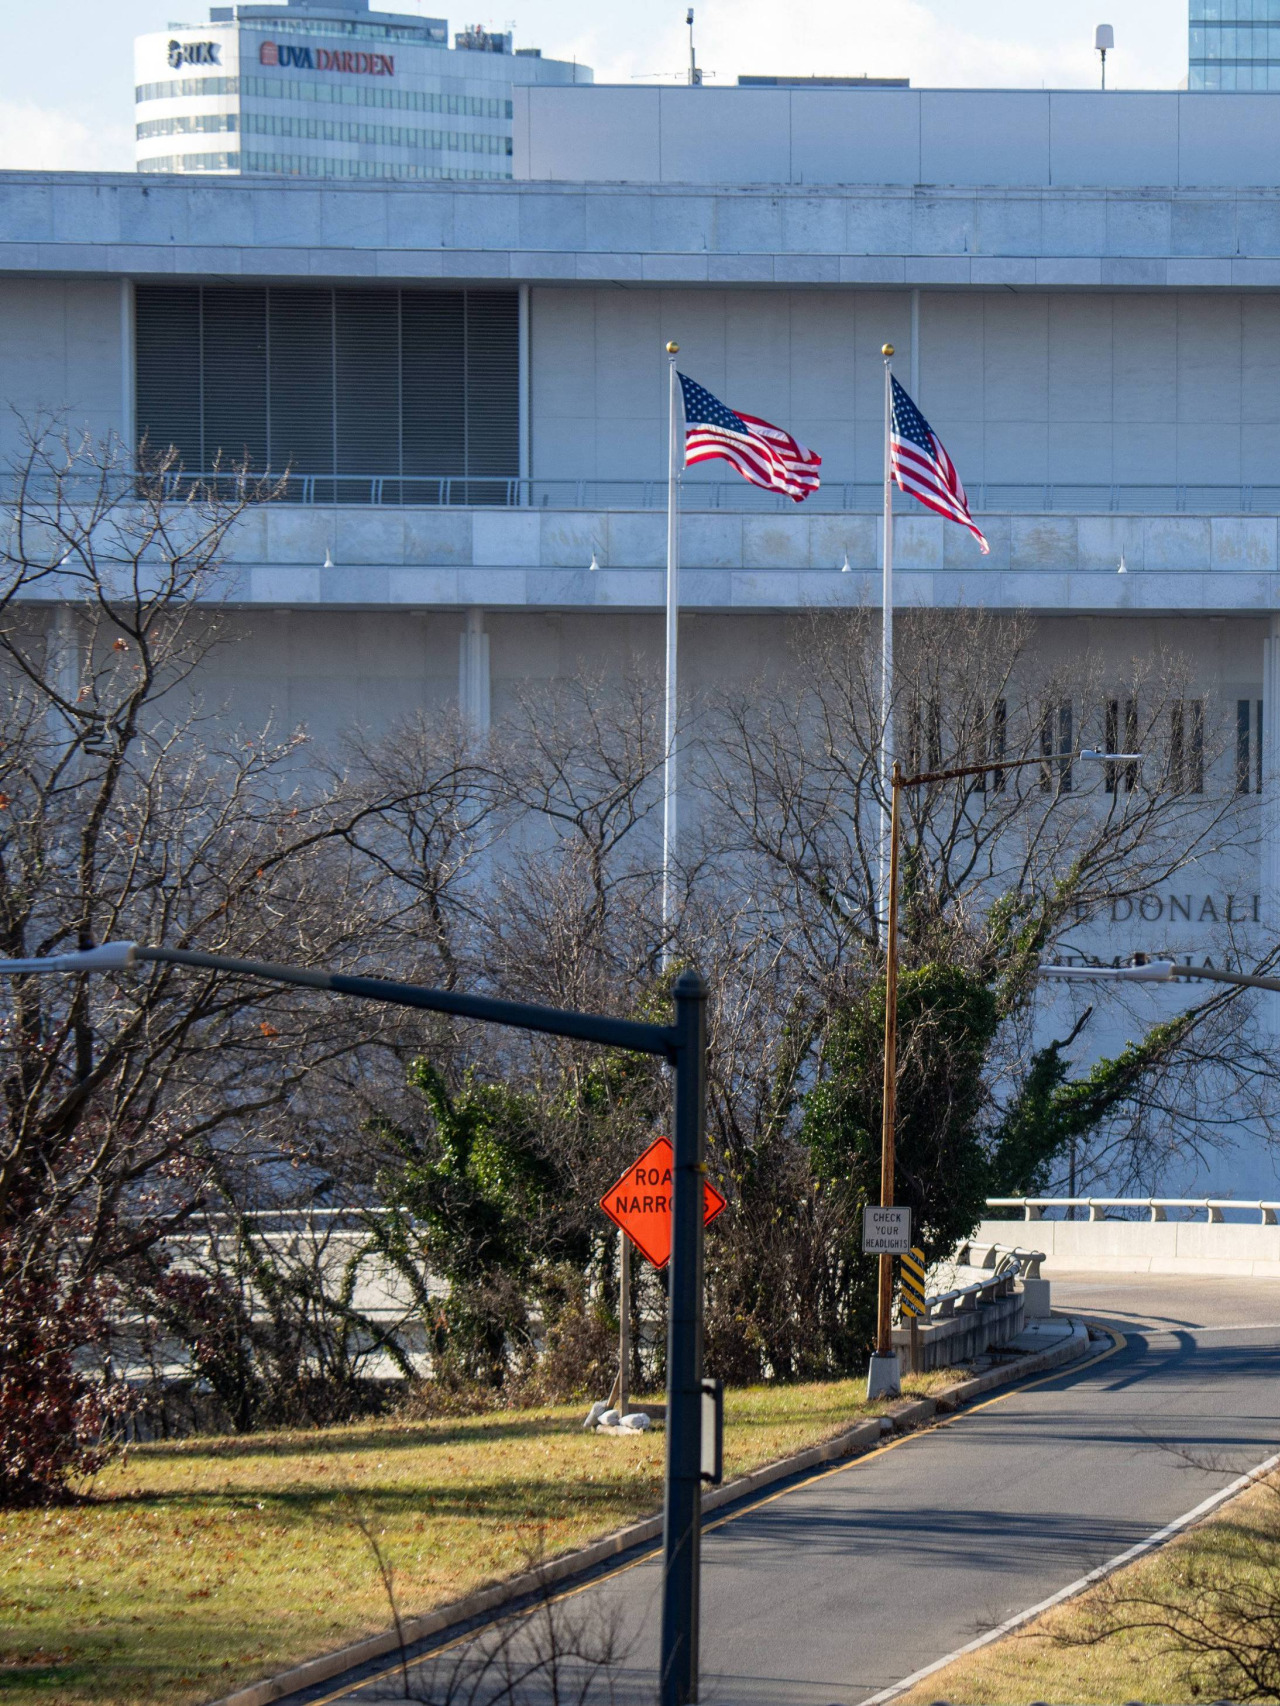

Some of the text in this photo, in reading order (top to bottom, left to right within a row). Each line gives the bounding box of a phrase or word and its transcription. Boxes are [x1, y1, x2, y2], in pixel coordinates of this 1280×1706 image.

[277, 45, 395, 76] UVA DARDEN
[635, 1168, 673, 1186] ROA
[616, 1196, 709, 1213] NARR
[873, 1213, 901, 1222] CHECK
[875, 1226, 899, 1235] YOUR
